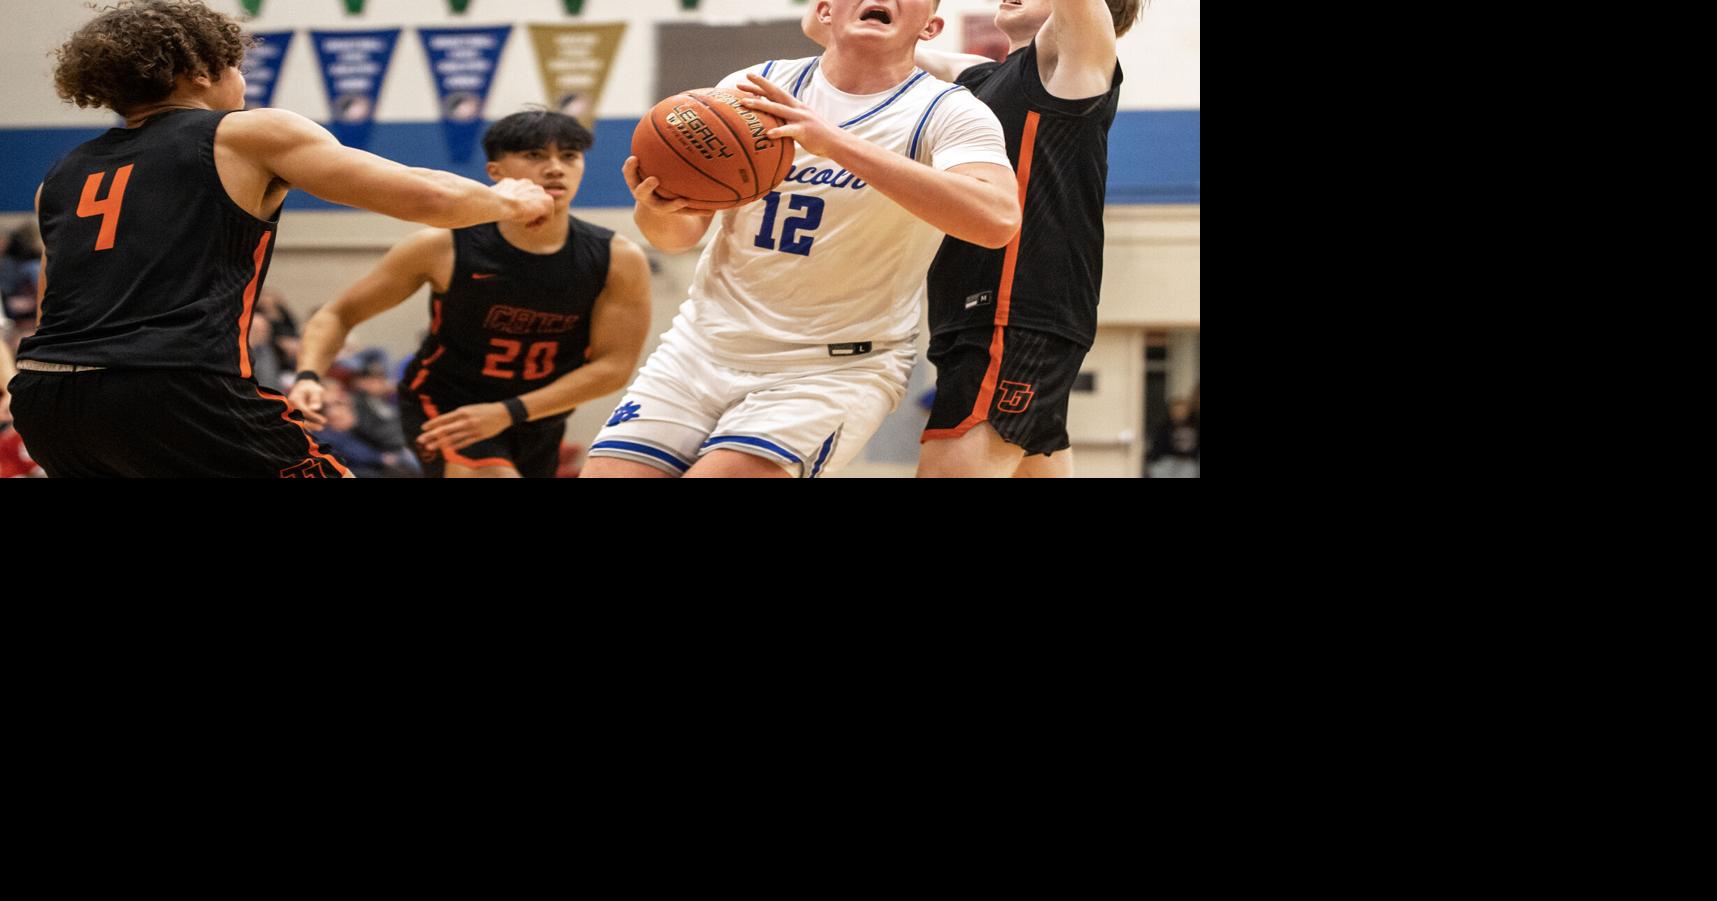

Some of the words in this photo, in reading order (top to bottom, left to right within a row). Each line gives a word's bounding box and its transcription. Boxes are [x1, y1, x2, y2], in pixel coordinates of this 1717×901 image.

[673, 105, 734, 159] LEGACY
[76, 163, 135, 252] 4
[754, 191, 825, 257] 12
[482, 338, 560, 381] 20
